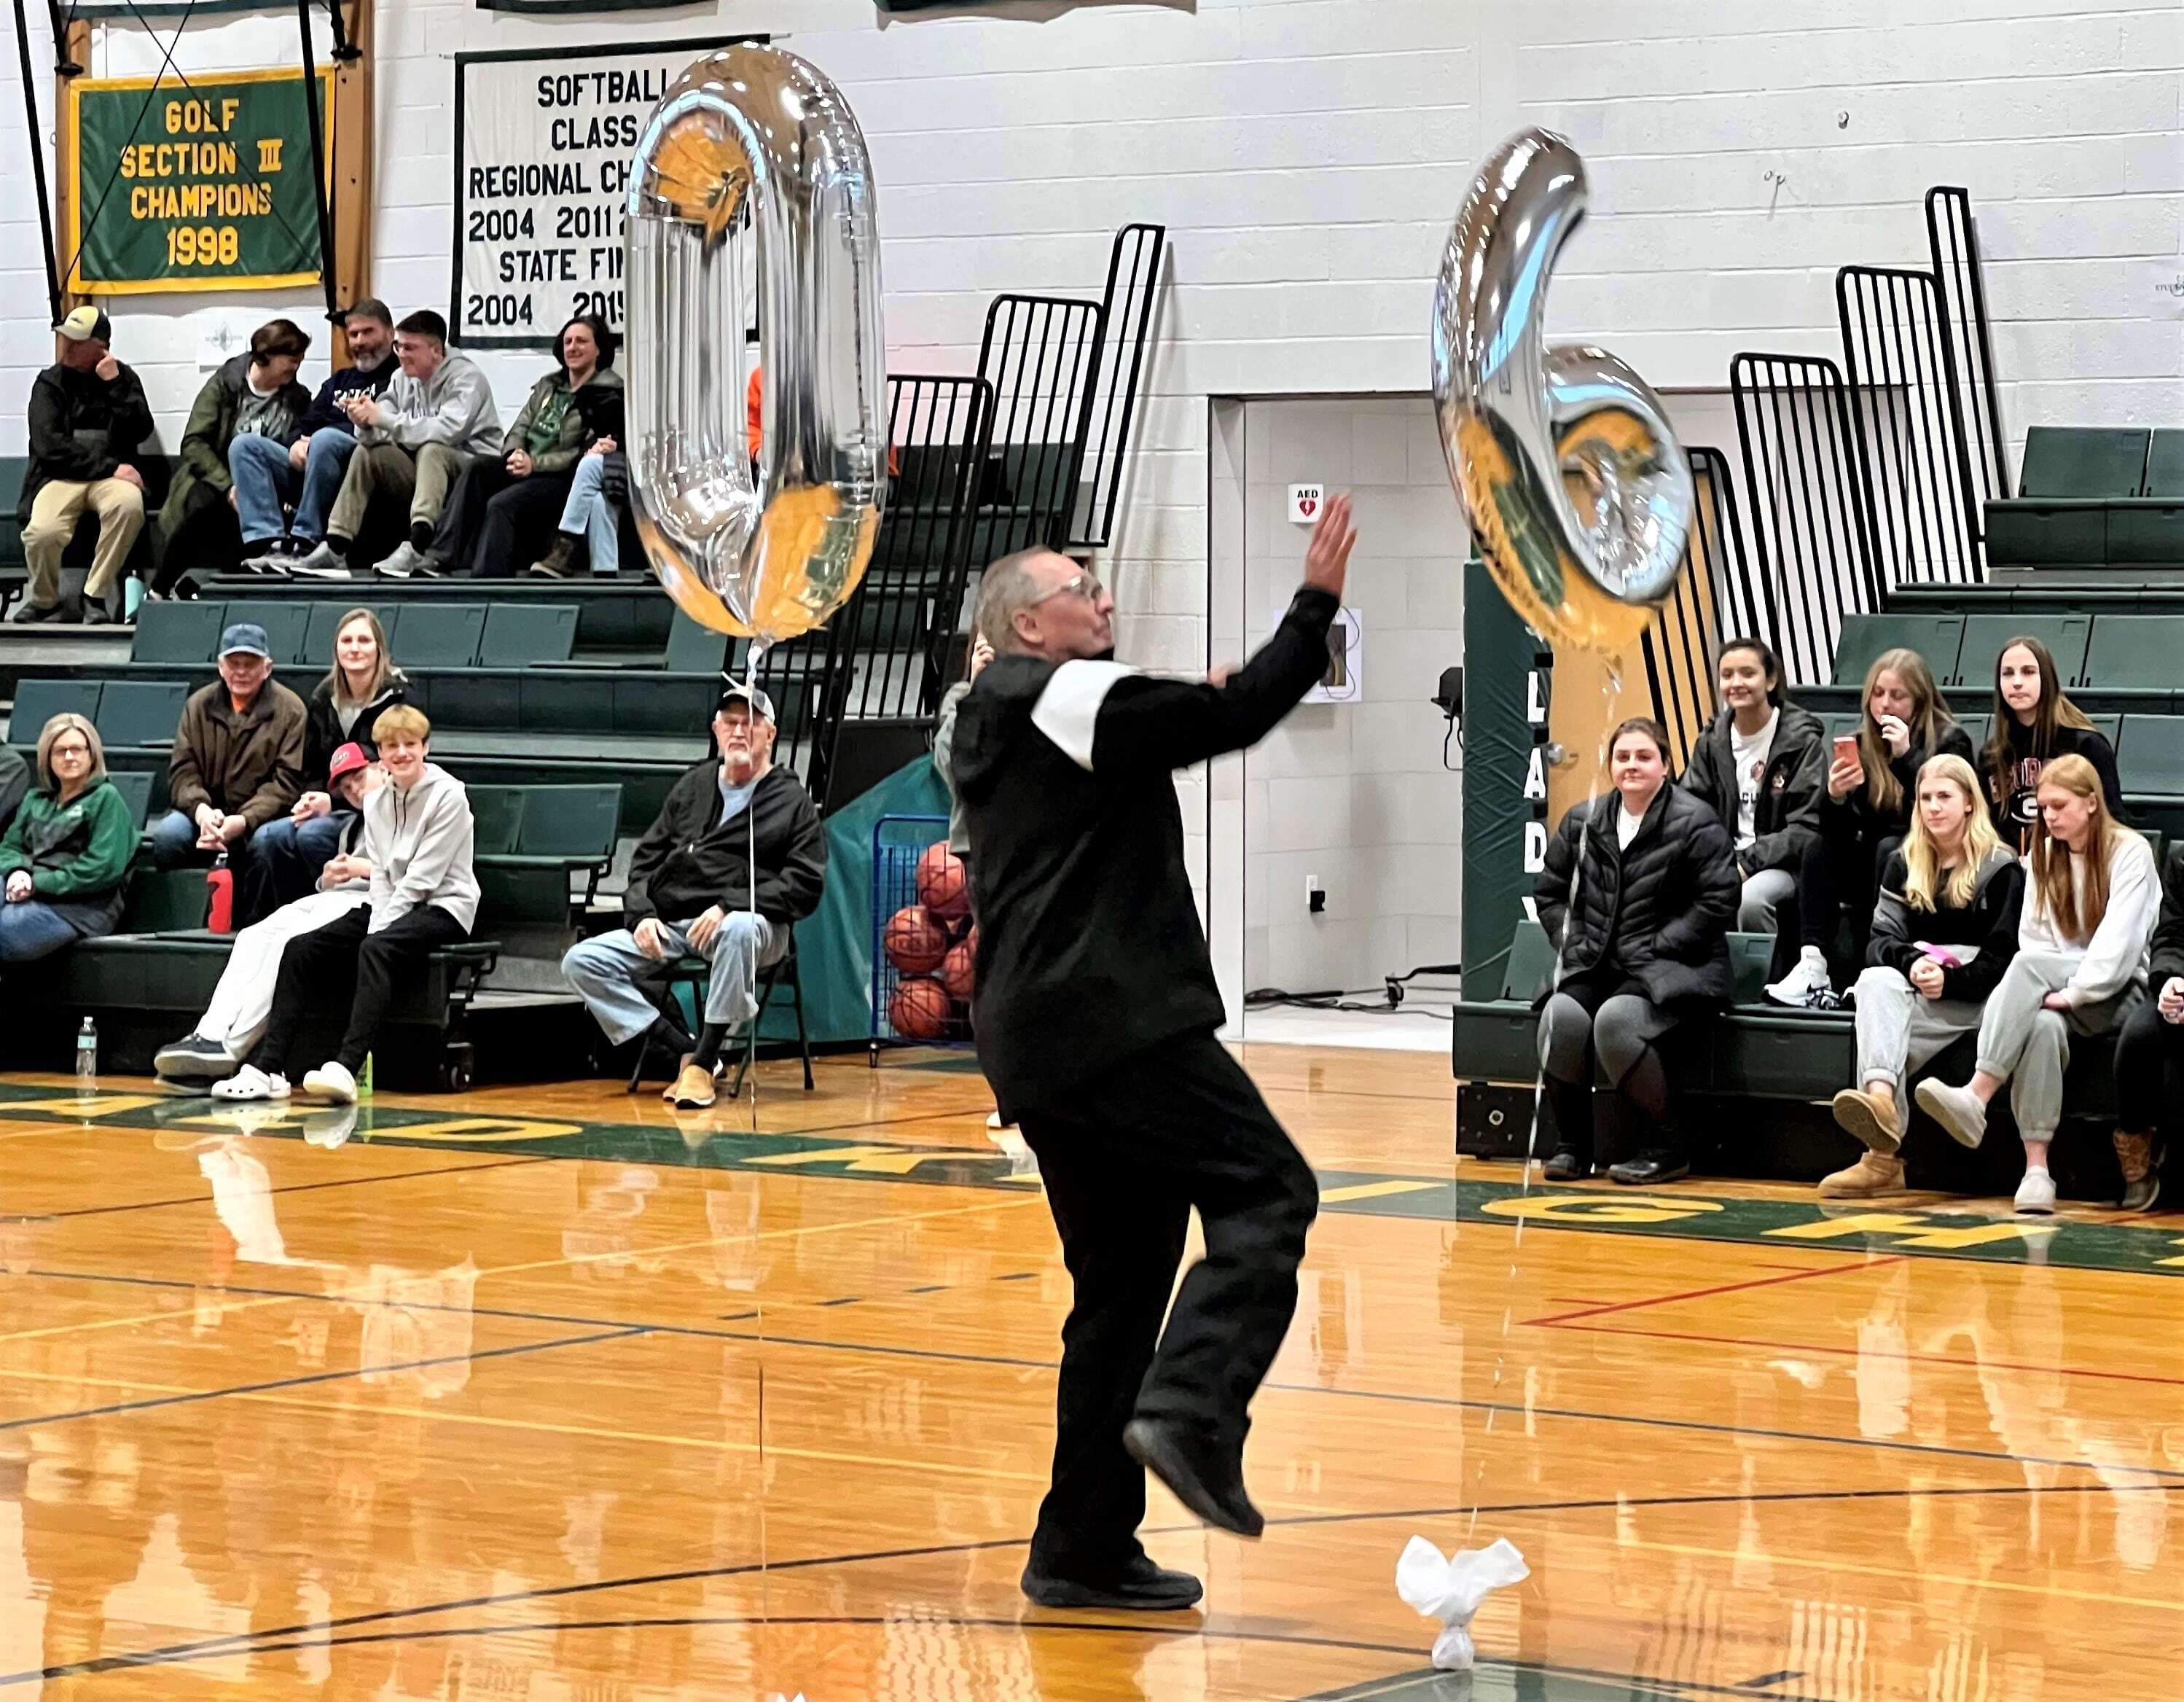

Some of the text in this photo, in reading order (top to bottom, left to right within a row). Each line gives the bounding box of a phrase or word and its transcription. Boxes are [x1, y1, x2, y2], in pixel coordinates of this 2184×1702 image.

[165, 98, 240, 134] GOLF
[552, 114, 637, 151] CLASS
[121, 138, 283, 178] SECTION III
[470, 163, 592, 199] REGIONAL
[131, 181, 272, 219] CHAMPIONS
[469, 208, 534, 241] 2004
[557, 205, 611, 238] 2011
[167, 225, 238, 266] 1998
[499, 249, 577, 283] STATE
[468, 294, 533, 325] 2004
[1297, 489, 1318, 498] AED
[1522, 671, 1546, 922] LAD
